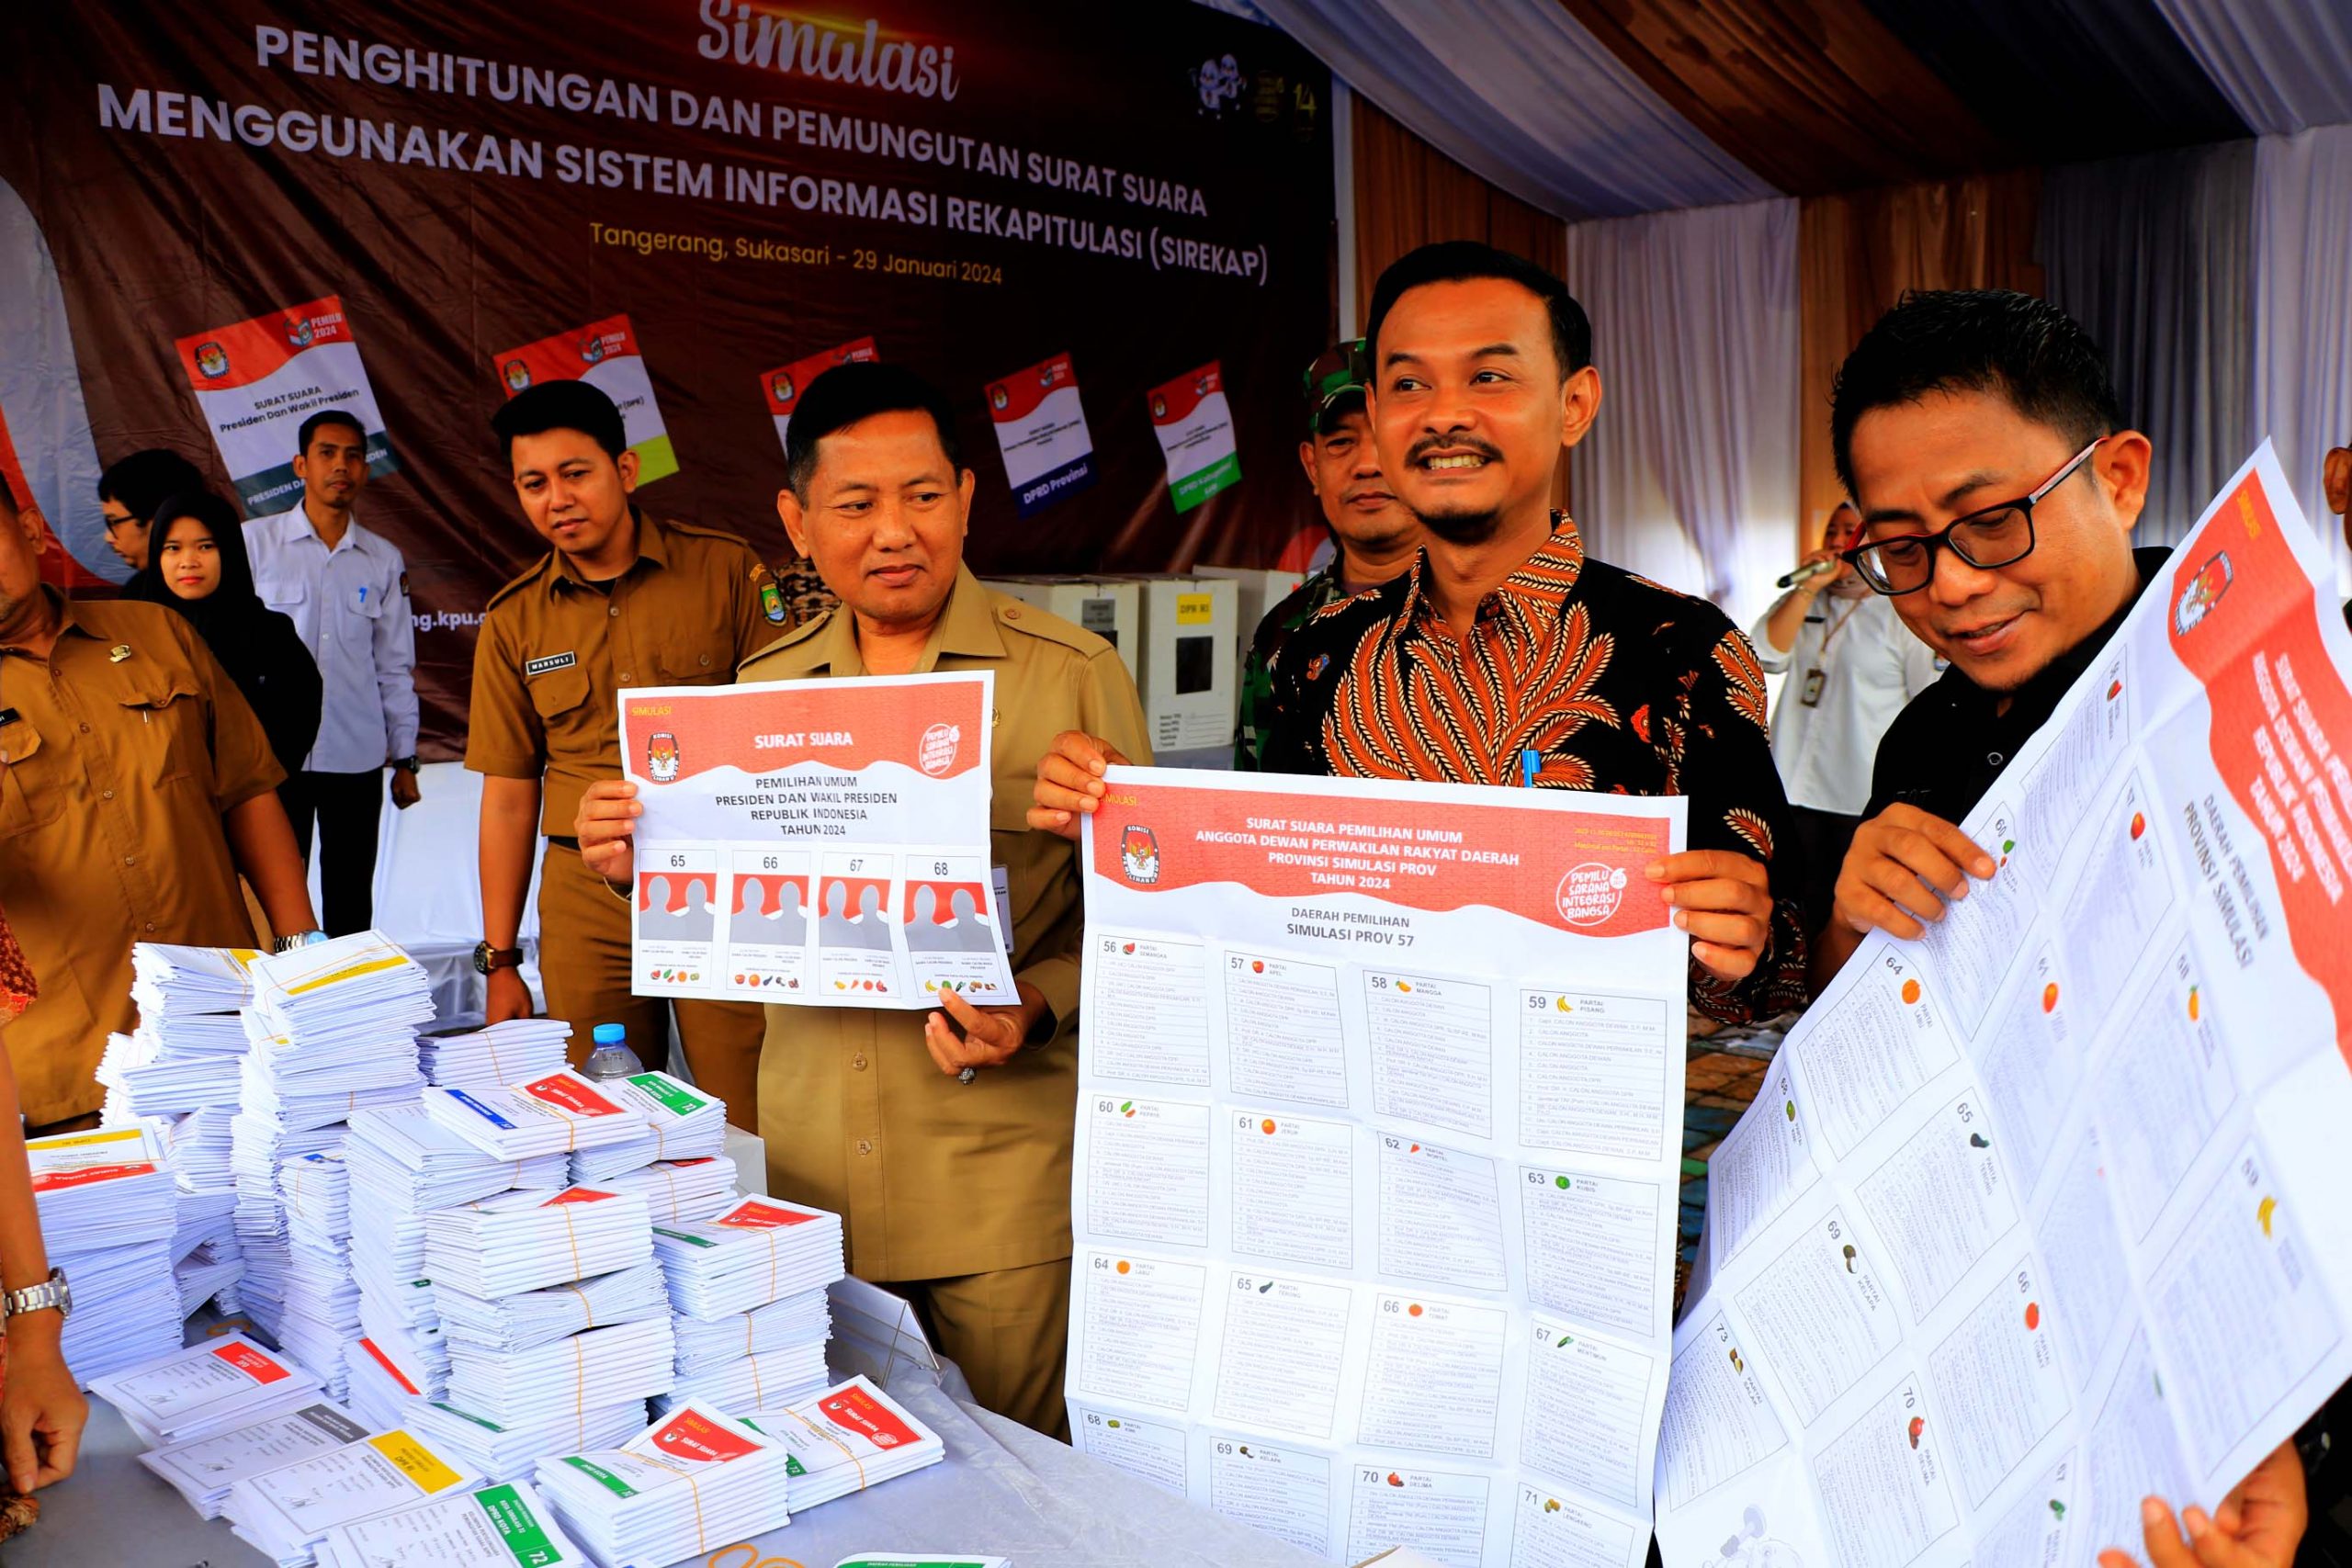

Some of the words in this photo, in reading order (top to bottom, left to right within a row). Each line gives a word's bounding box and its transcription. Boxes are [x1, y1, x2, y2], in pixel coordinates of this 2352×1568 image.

[698, 0, 960, 102] Simulasi
[255, 25, 659, 122] PENGHITUNGAN
[671, 90, 761, 137] DAN
[773, 106, 1019, 179] PEMUNGUTAN
[1027, 152, 1117, 197] SURAT
[1123, 173, 1207, 217] SUARA
[97, 84, 543, 180] MENGGUNAKAN
[556, 145, 713, 199] SISTEM
[725, 166, 937, 227] INFORMASI
[947, 197, 1143, 259] REKAPITULASI
[1150, 227, 1268, 286] (SIREKAP)
[590, 222, 729, 262] Tangerang,
[736, 238, 829, 265] Sukasari
[854, 249, 877, 270] 29
[883, 254, 958, 279] Januari
[961, 262, 1002, 284] 2024
[314, 325, 337, 339] 2024
[254, 395, 286, 411] SURAT
[288, 386, 322, 400] SUARA
[220, 414, 266, 433] Presiden
[267, 409, 288, 421] Dan
[288, 399, 318, 414] Wakil
[319, 389, 359, 407] Presiden
[247, 482, 293, 506] PRESIDEN
[294, 478, 305, 492] DA
[631, 705, 672, 716] SIMULASI
[754, 733, 805, 749] SURAT
[809, 732, 853, 746] SUARA
[756, 776, 821, 789] PEMILIHAN
[824, 776, 857, 787] UMUM
[716, 795, 774, 806] PRESIDEN
[778, 793, 807, 804] DAN
[810, 793, 842, 804] WAKIL
[844, 793, 897, 804] PRESIDEN
[751, 809, 808, 820] REPUBLIK
[813, 808, 867, 820] INDONESIA
[781, 824, 821, 835] TAHUN
[823, 825, 846, 835] 2024
[1126, 825, 1149, 834] KOMISI
[1246, 818, 1286, 830] SURAT
[1290, 820, 1334, 834] SUARA
[1339, 824, 1412, 840] PEMILIHAN
[1416, 829, 1463, 843] UMUM
[1996, 818, 2007, 838] 60
[2203, 793, 2232, 857] DAERAH
[1196, 830, 1257, 844] ANGGOTA
[1260, 835, 1308, 849] DEWAN
[1312, 839, 1399, 856] PERWAKILAN
[1404, 845, 1457, 861] RAKYAT
[1461, 850, 1519, 865] DAERAH
[670, 855, 686, 868] 65
[763, 856, 779, 869] 66
[849, 859, 864, 872] 67
[1268, 852, 1329, 867] PROVINSI
[1332, 857, 1396, 873] SIMULASI
[1399, 863, 1437, 875] PROV
[933, 863, 949, 875] 68
[1310, 873, 1355, 886] TAHUN
[1359, 876, 1390, 889] 2024
[1571, 870, 1610, 884] PEMILU
[1568, 882, 1610, 897] SARANA
[2184, 800, 2218, 883] PROVINSI
[2213, 880, 2254, 970] SIMULASI
[1562, 892, 1615, 908] INTEGRASI
[1292, 908, 1340, 921] DAERAH
[1343, 912, 1409, 928] PEMILIHAN
[1567, 905, 1610, 919] BANGSA
[1287, 923, 1351, 941] SIMULASI
[1355, 931, 1394, 945] PROV
[1397, 934, 1414, 947] 57
[1103, 941, 1116, 953] 56
[1139, 951, 1167, 959] SEMANGKA
[1231, 957, 1244, 969] 57
[1886, 957, 1903, 976] 64
[1372, 976, 1387, 988] 58
[1529, 996, 1546, 1009] 59
[1580, 1006, 1604, 1014] PISANG
[1099, 1101, 1113, 1112] 60
[1957, 1102, 1973, 1123] 65
[1239, 1117, 1252, 1129] 61
[1385, 1138, 1400, 1150] 62
[1529, 1172, 1545, 1184] 63
[1827, 1220, 1840, 1240] 69
[1094, 1258, 1108, 1269] 64
[1238, 1278, 1251, 1291] 65
[1863, 1274, 1880, 1303] PARTAI
[2018, 1270, 2030, 1293] 66
[1858, 1280, 1876, 1312] KELAPA
[1384, 1301, 1399, 1314] 66
[1536, 1328, 1551, 1342] 67
[1716, 1323, 1728, 1343] 73
[1747, 1376, 1762, 1404] PARTAI
[1903, 1387, 1916, 1409] 70
[844, 1407, 863, 1422] SURAT
[860, 1418, 879, 1432] SUARA
[1087, 1414, 1101, 1426] 68
[681, 1437, 700, 1450] SURAT
[697, 1444, 718, 1457] SUARA
[1217, 1443, 1232, 1455] 69
[1363, 1471, 1378, 1483] 70
[1525, 1491, 1537, 1505] 71
[487, 1505, 502, 1520] DPRD
[497, 1518, 512, 1535] KOTA
[528, 1551, 548, 1564] 72
